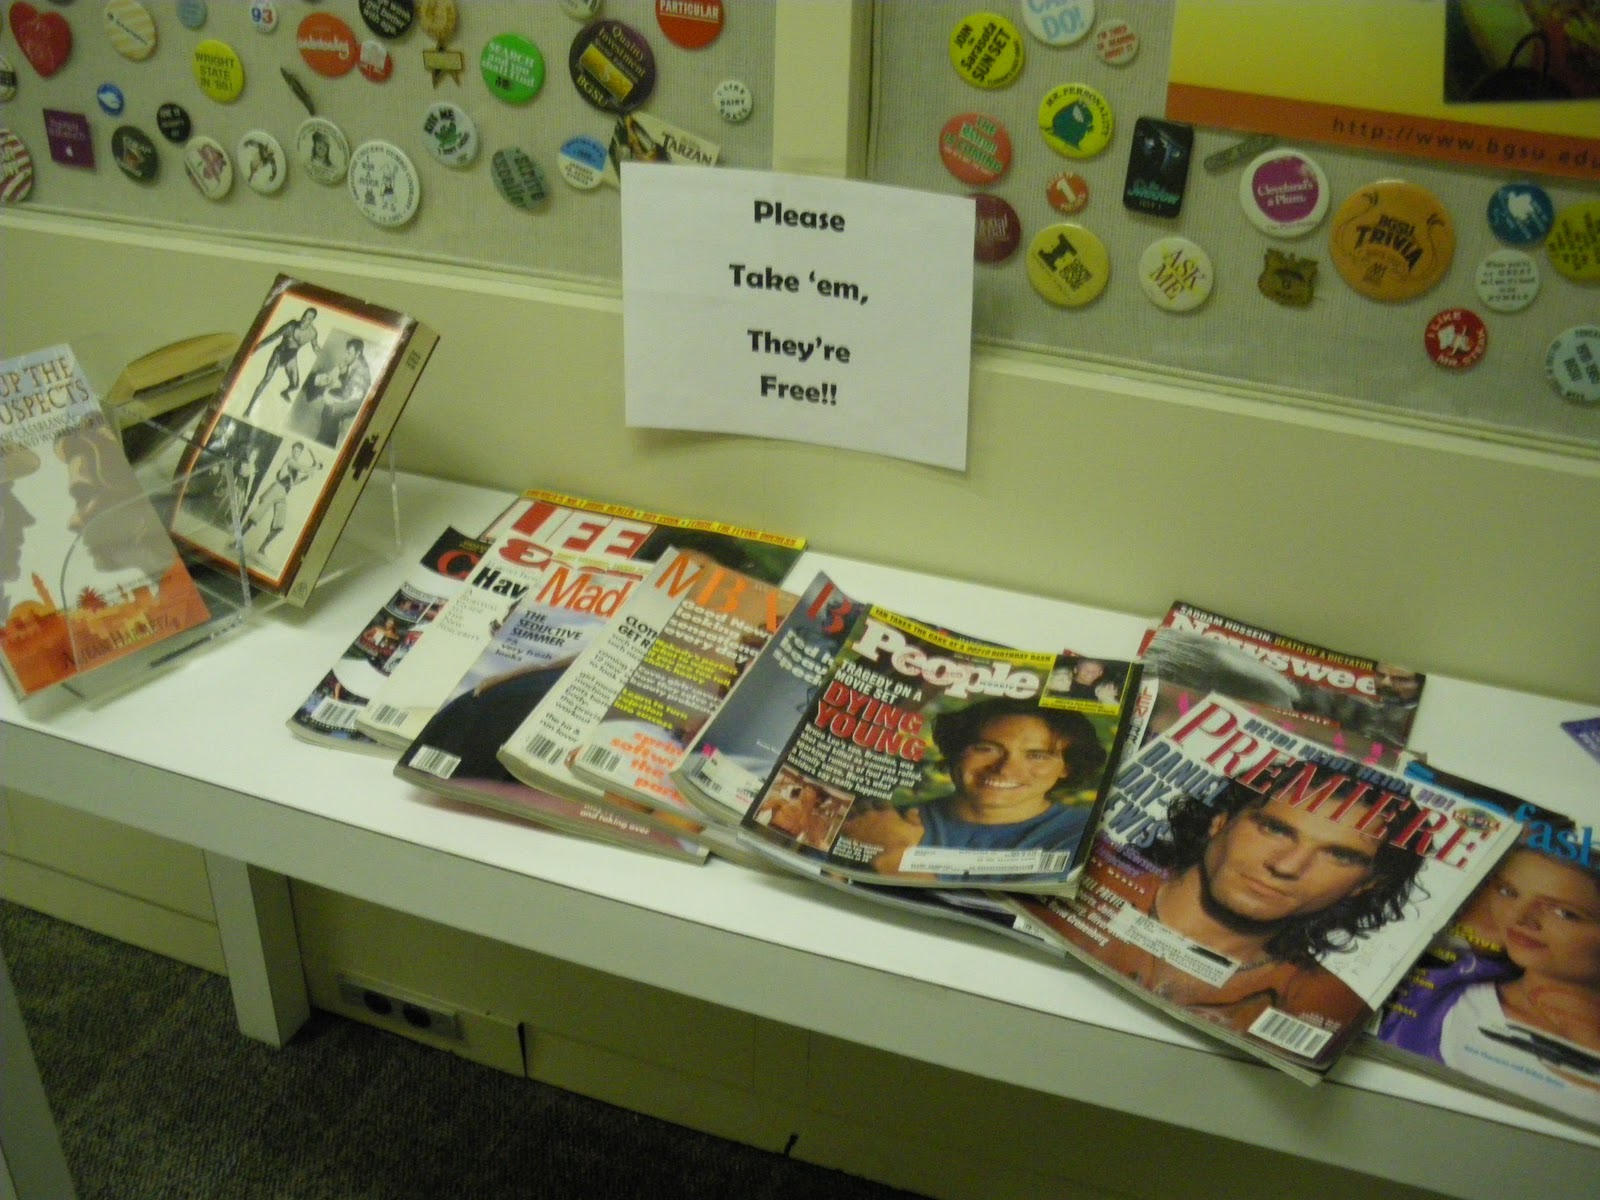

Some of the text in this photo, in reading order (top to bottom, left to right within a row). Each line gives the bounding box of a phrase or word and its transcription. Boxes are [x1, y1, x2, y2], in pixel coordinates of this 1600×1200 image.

[659, 0, 719, 20] PARTICULAR
[662, 131, 713, 167] TARZAN
[1257, 178, 1313, 197] Cleveland's
[754, 200, 846, 232] Please
[1355, 225, 1423, 272] TRIVIA
[729, 264, 800, 292] Take
[1150, 264, 1184, 301] ME
[1164, 250, 1205, 290] ASK
[23, 357, 75, 388] THE
[760, 375, 838, 406] Free!!
[525, 609, 547, 622] THE
[675, 606, 740, 639] looking
[682, 599, 728, 622] Good
[510, 627, 565, 647] SUMMER
[518, 618, 583, 641] SEDUCTIVE
[618, 625, 640, 642] GET
[664, 627, 749, 664] every day
[890, 616, 913, 631] TAKES
[913, 625, 927, 638] THE
[928, 631, 947, 645] CAKE
[991, 650, 1028, 660] BIRTHDAY
[1179, 604, 1224, 628] SADDAM
[1225, 618, 1273, 644] HUSSEIN:
[1274, 635, 1304, 653] DEATH
[1305, 645, 1319, 658] OF
[1328, 652, 1374, 672] DICTATOR
[852, 617, 1040, 699] People
[1169, 611, 1378, 697] Newswee
[835, 669, 898, 704] MOVIE SET
[841, 660, 922, 702] TRAGEDY ON A
[823, 680, 924, 736] DYING
[805, 722, 825, 740] Bruce
[827, 734, 846, 750] Lee's
[900, 761, 914, 770] was
[814, 700, 926, 762] YOUNG
[1243, 718, 1298, 751] HEIDI
[796, 739, 827, 760] sparking
[828, 756, 855, 773] rumors
[865, 768, 881, 780] foul
[881, 773, 898, 786] play
[899, 778, 915, 789] and
[798, 750, 820, 769] family
[845, 771, 871, 786] Here's
[872, 778, 892, 791] what
[800, 732, 816, 746] shot
[817, 740, 831, 752] and
[831, 745, 853, 760] killed
[864, 760, 897, 774] cameras
[817, 770, 830, 783] say
[831, 775, 853, 791] really
[855, 782, 893, 801] happened
[1138, 741, 1230, 807] DANIEL
[1168, 701, 1491, 869] PREMIERE
